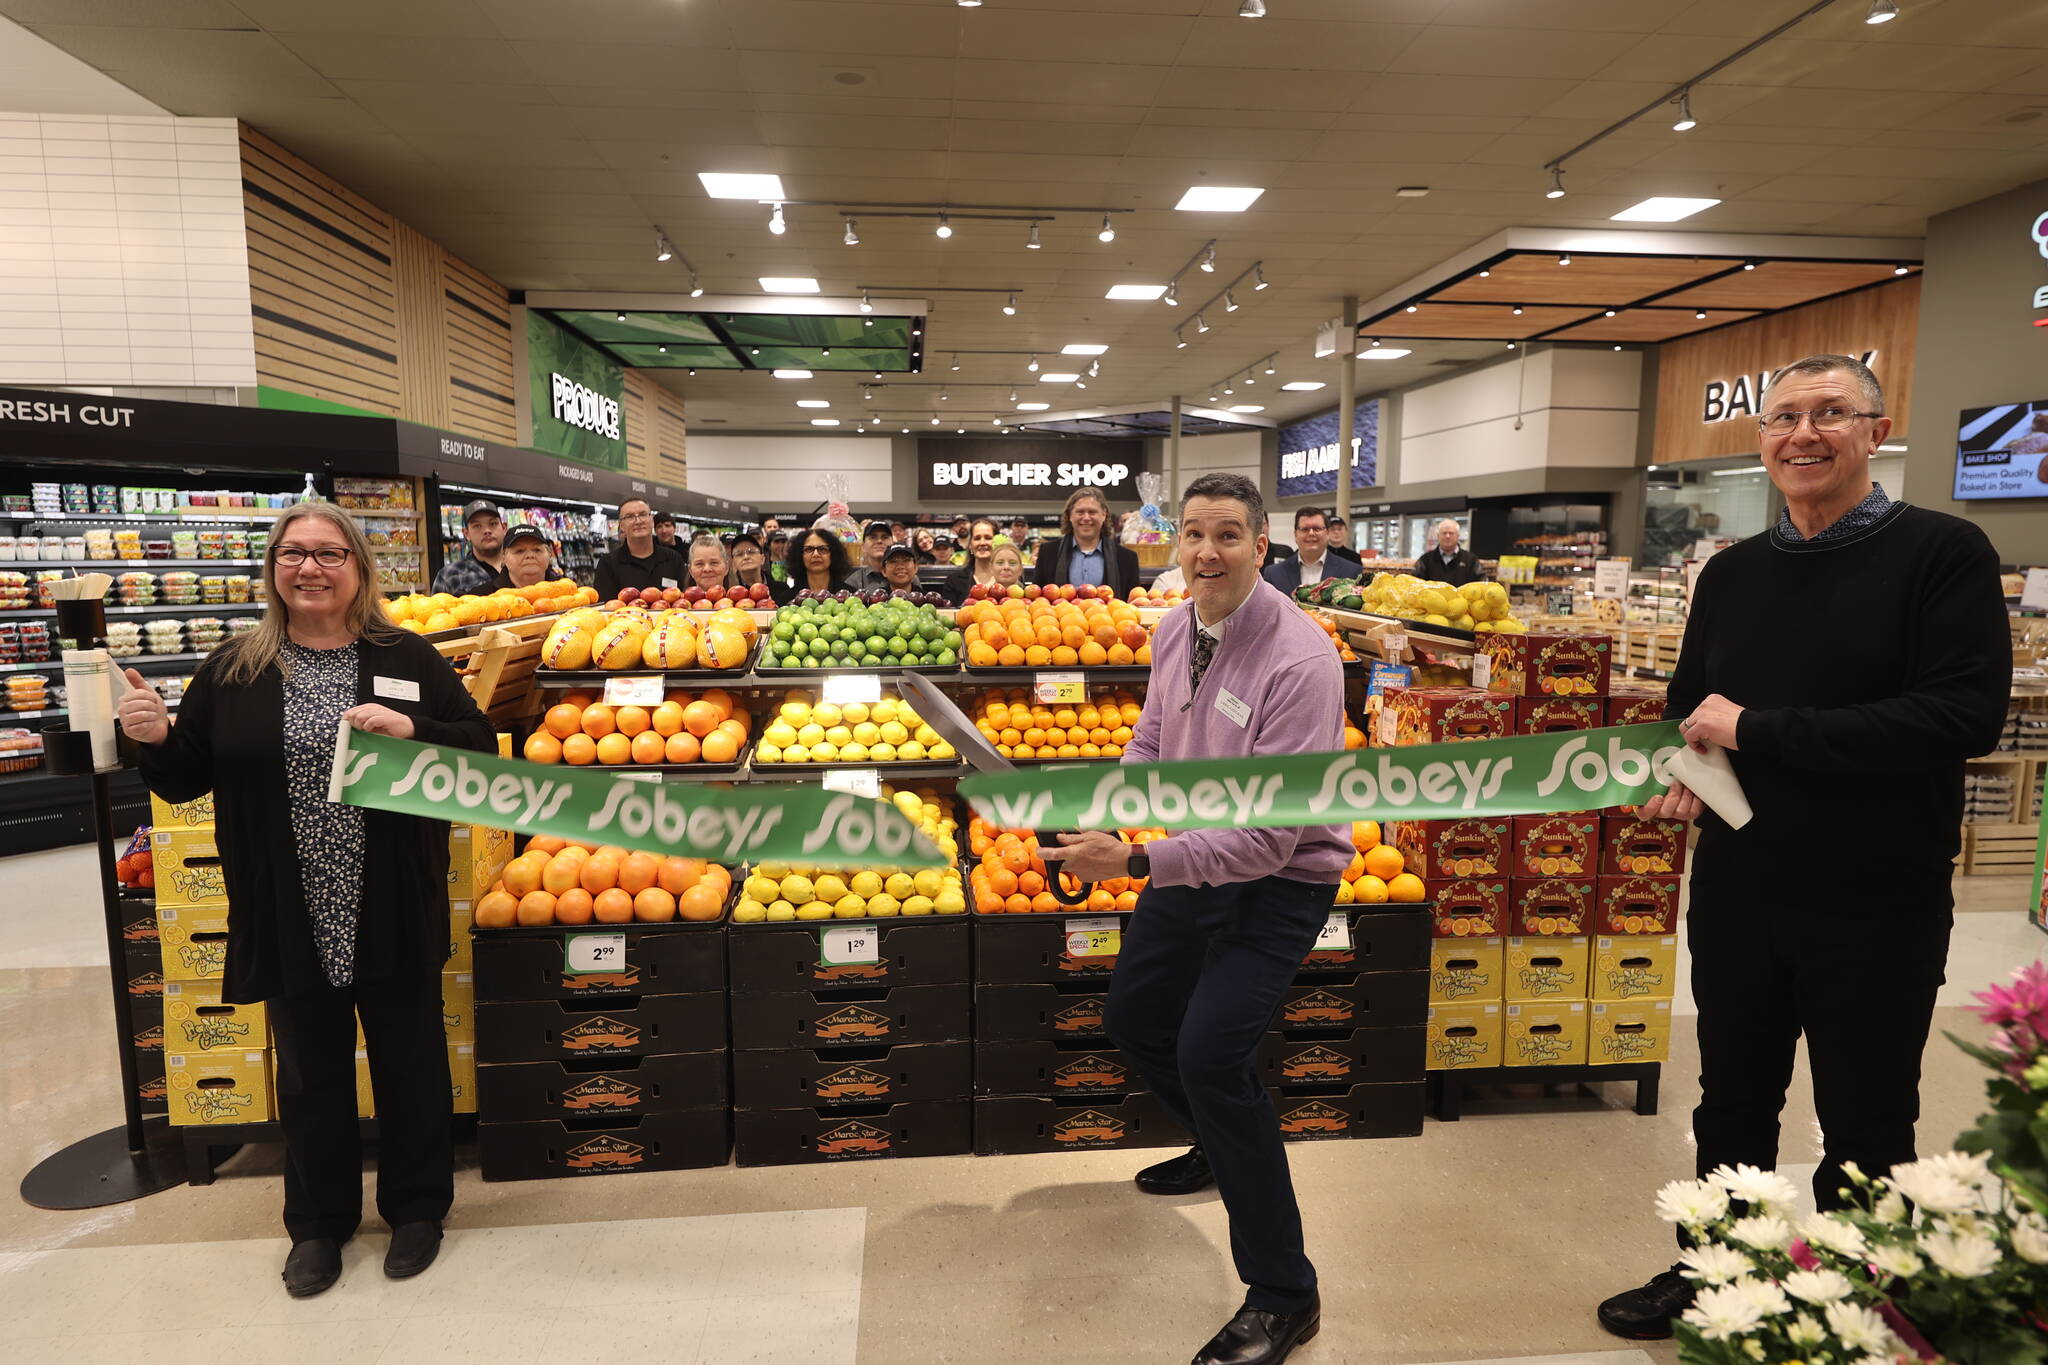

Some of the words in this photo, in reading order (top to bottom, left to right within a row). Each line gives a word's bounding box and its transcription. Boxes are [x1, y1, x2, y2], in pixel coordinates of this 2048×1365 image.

[552, 372, 619, 440] PRODUCE
[80, 406, 134, 427] CUT
[441, 439, 462, 456] READY
[463, 444, 473, 458] TO
[474, 446, 485, 461] EAT
[1282, 451, 1306, 479] FISH
[1306, 438, 1361, 475] MART
[1966, 455, 1985, 463] BAKE
[1987, 453, 2008, 462] SHOP
[559, 465, 580, 480] PACKAGED
[933, 463, 1051, 486] BUTCHER
[1056, 463, 1128, 486] SHOP
[1961, 471, 1998, 479] Premium
[2000, 469, 2034, 478] Quality
[1960, 482, 1986, 491] Baked
[1989, 482, 1997, 490] in
[2000, 481, 2022, 490] Store
[1555, 651, 1586, 661] Sunkist
[1458, 711, 1489, 721] Sunkist
[1547, 712, 1577, 721] Sunkist
[1638, 712, 1661, 721] Sunki
[1078, 767, 1284, 829] Sobeys
[1308, 753, 1513, 814] Sobeys
[1536, 735, 1682, 797] Sobe
[389, 748, 573, 826] Sobeys
[587, 780, 784, 857] Sobeys
[1454, 833, 1485, 843] Sunkist
[1542, 833, 1572, 842] Sunkist
[1633, 832, 1662, 841] Sunkist
[1452, 893, 1482, 902] Sunkist
[1540, 893, 1570, 902] Sunkist
[1625, 891, 1655, 901] Sunkist
[1296, 1000, 1326, 1008] Maroc
[1326, 999, 1342, 1008] Star
[1066, 1008, 1098, 1017] Maroc
[828, 1015, 860, 1024] Maroc
[860, 1015, 877, 1024] Star
[575, 1026, 607, 1035] Maroc
[607, 1025, 626, 1035] Star
[1294, 1055, 1324, 1063] Maroc
[1324, 1054, 1340, 1063] Star
[1066, 1065, 1098, 1073] Maroc
[828, 1076, 860, 1084] Maroc
[859, 1075, 877, 1084] Star
[576, 1086, 608, 1094] Maroc
[608, 1085, 627, 1094] Star
[1292, 1110, 1322, 1118] Maroc
[1321, 1110, 1337, 1119] Star
[1066, 1119, 1096, 1127] Maroc
[1095, 1118, 1112, 1128] Star
[829, 1131, 861, 1139] Maroc
[861, 1130, 878, 1139] Star
[579, 1145, 611, 1154] Maroc
[611, 1144, 629, 1153] Star
